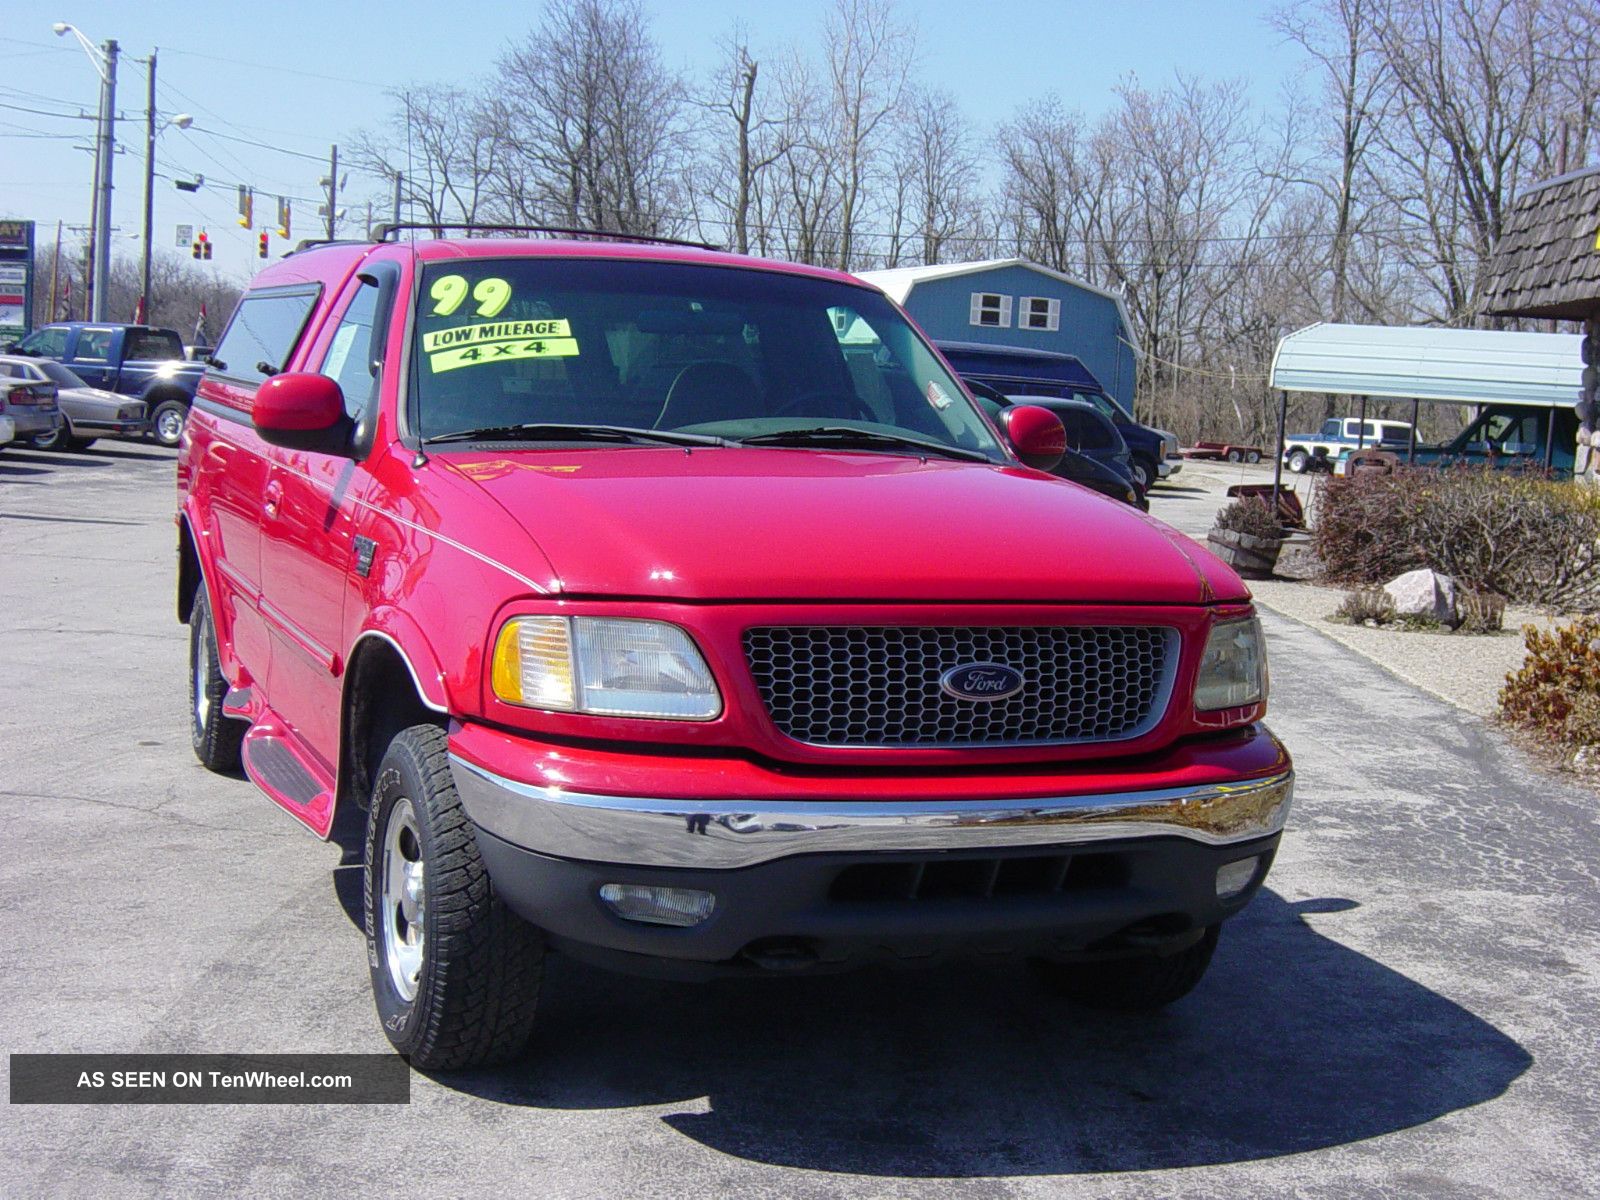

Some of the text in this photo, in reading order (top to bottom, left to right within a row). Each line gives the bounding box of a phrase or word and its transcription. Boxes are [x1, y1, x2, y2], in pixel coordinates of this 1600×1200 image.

[430, 274, 512, 318] 99
[432, 321, 558, 347] LOW MILEAGE
[963, 670, 1007, 691] Ford
